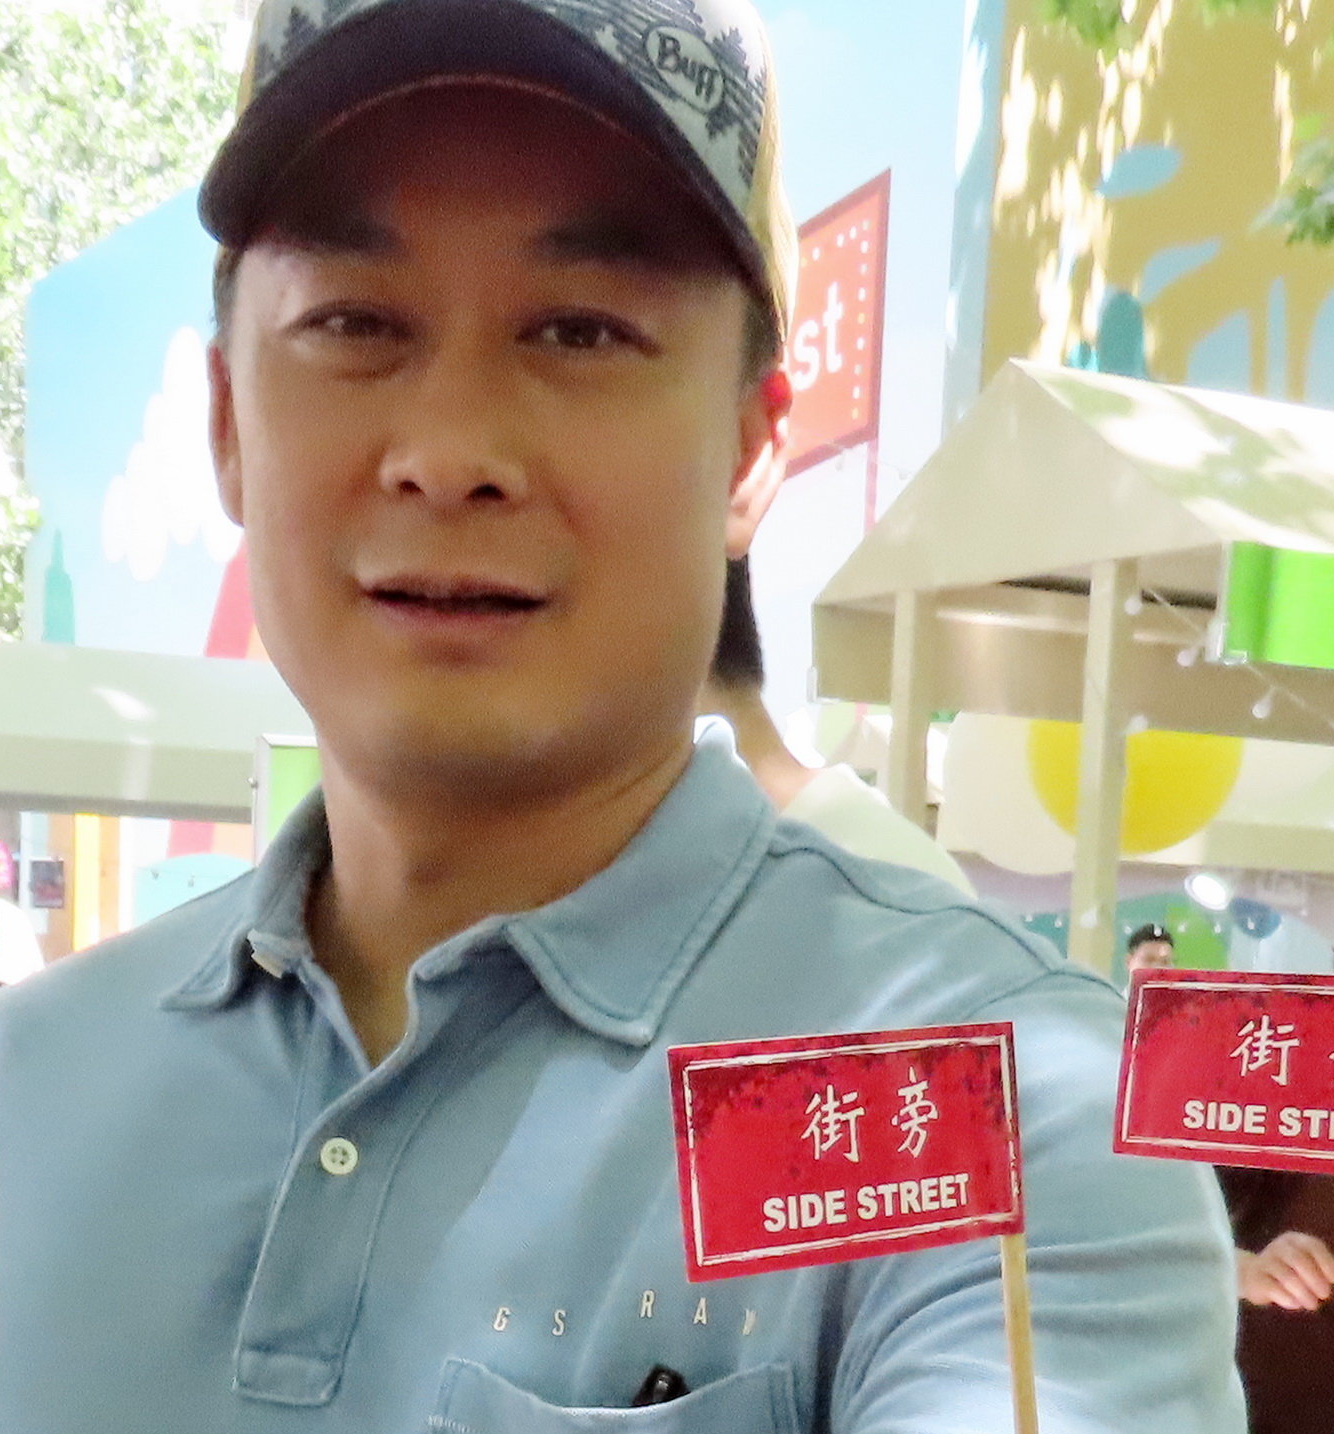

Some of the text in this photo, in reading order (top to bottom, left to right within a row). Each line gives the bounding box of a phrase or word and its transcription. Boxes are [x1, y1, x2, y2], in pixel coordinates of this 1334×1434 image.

[657, 32, 718, 103] Buff
[801, 1066, 939, 1163] 街旁
[1182, 1099, 1268, 1135] SIDE
[763, 1173, 970, 1233] SIDE STREET
